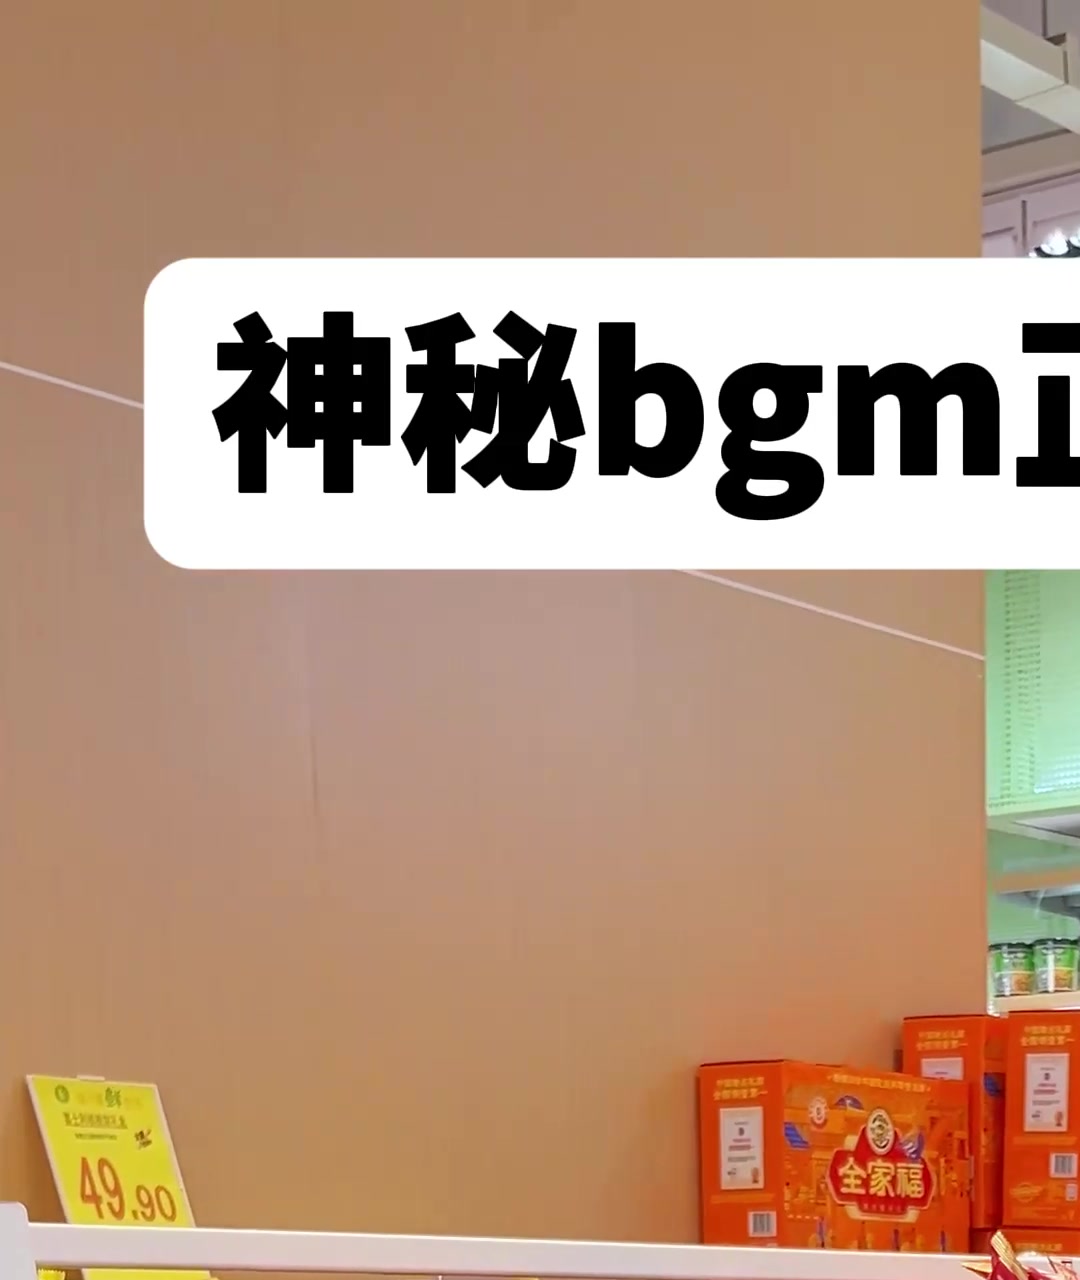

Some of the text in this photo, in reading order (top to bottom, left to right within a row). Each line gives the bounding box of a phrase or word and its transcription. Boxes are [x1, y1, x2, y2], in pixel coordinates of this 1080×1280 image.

[80, 1156, 177, 1222] 49.90
[837, 1156, 925, 1198] 全家福
